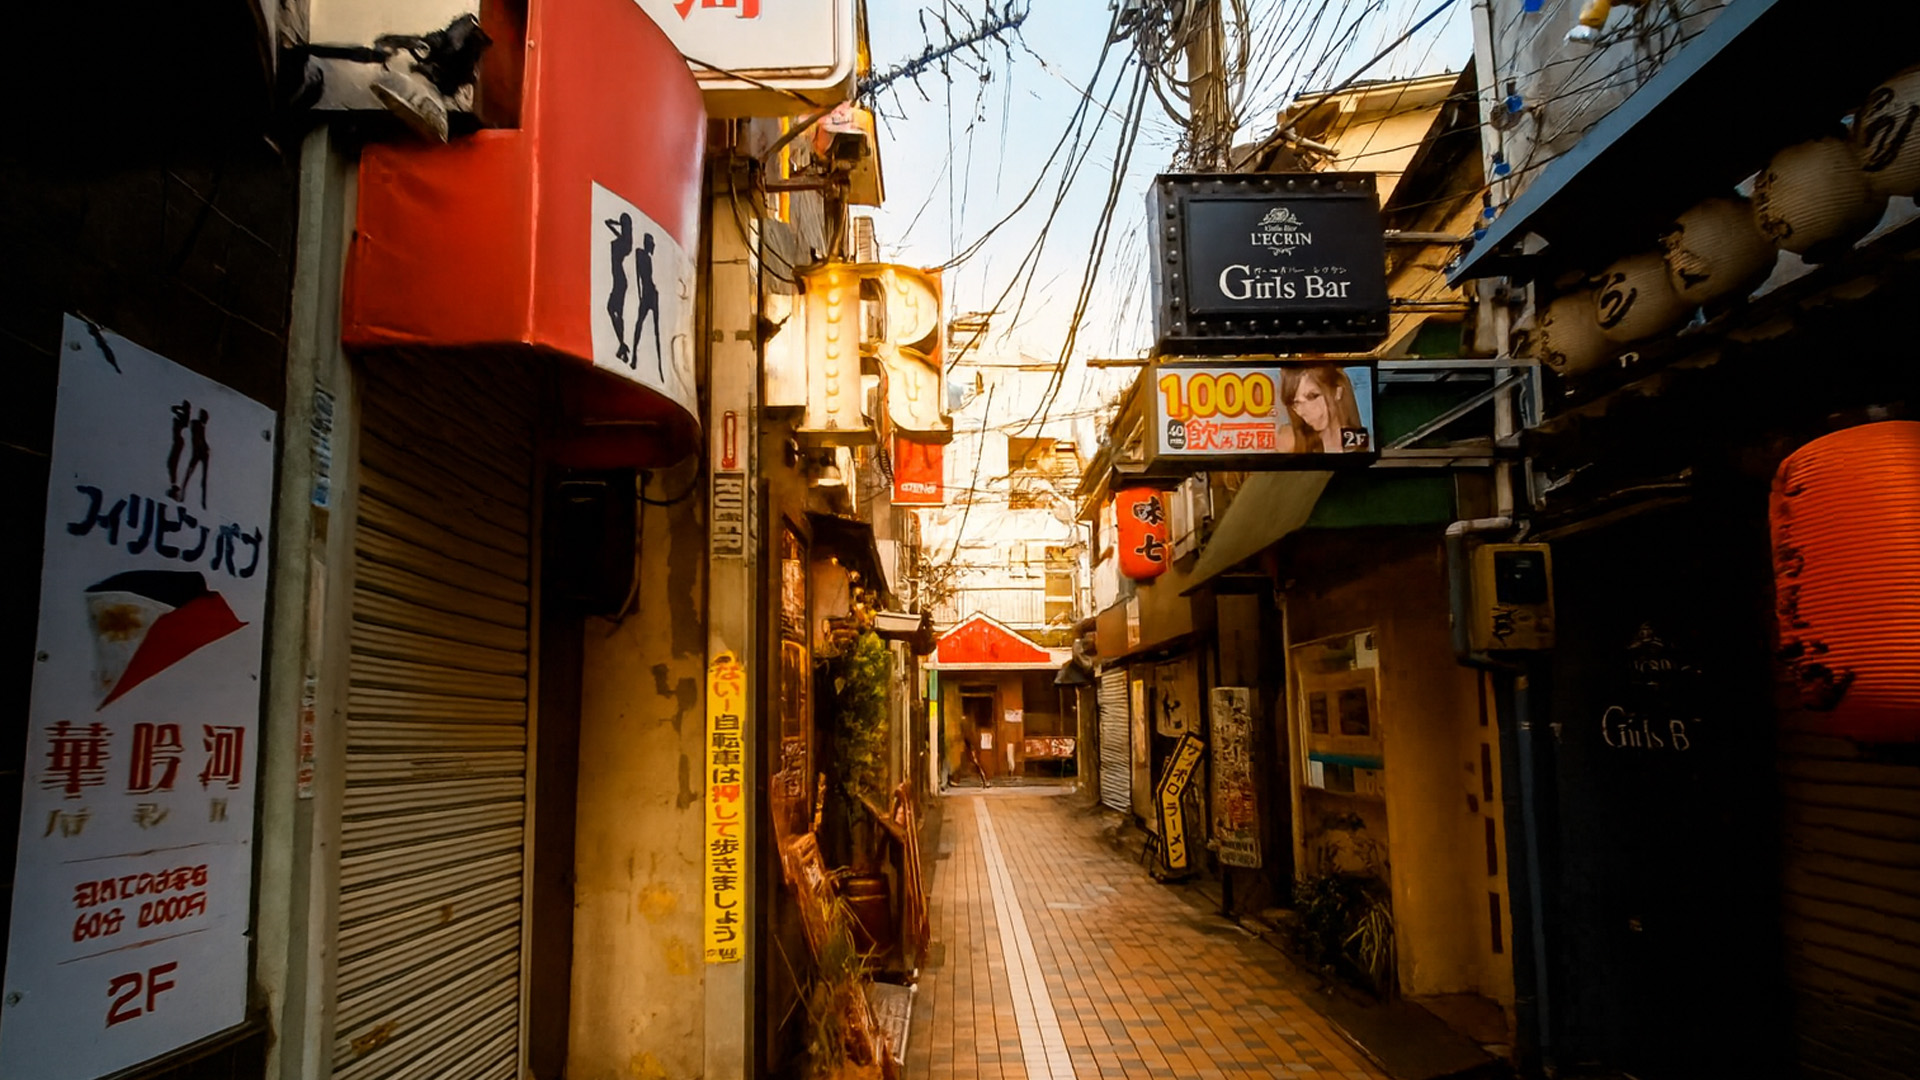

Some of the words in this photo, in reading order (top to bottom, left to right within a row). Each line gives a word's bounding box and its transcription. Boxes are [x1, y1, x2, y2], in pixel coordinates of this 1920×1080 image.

[1219, 264, 1296, 300] Girls
[1305, 275, 1351, 299] Bar
[1343, 431, 1366, 447] 2F
[106, 961, 179, 1029] 2F
